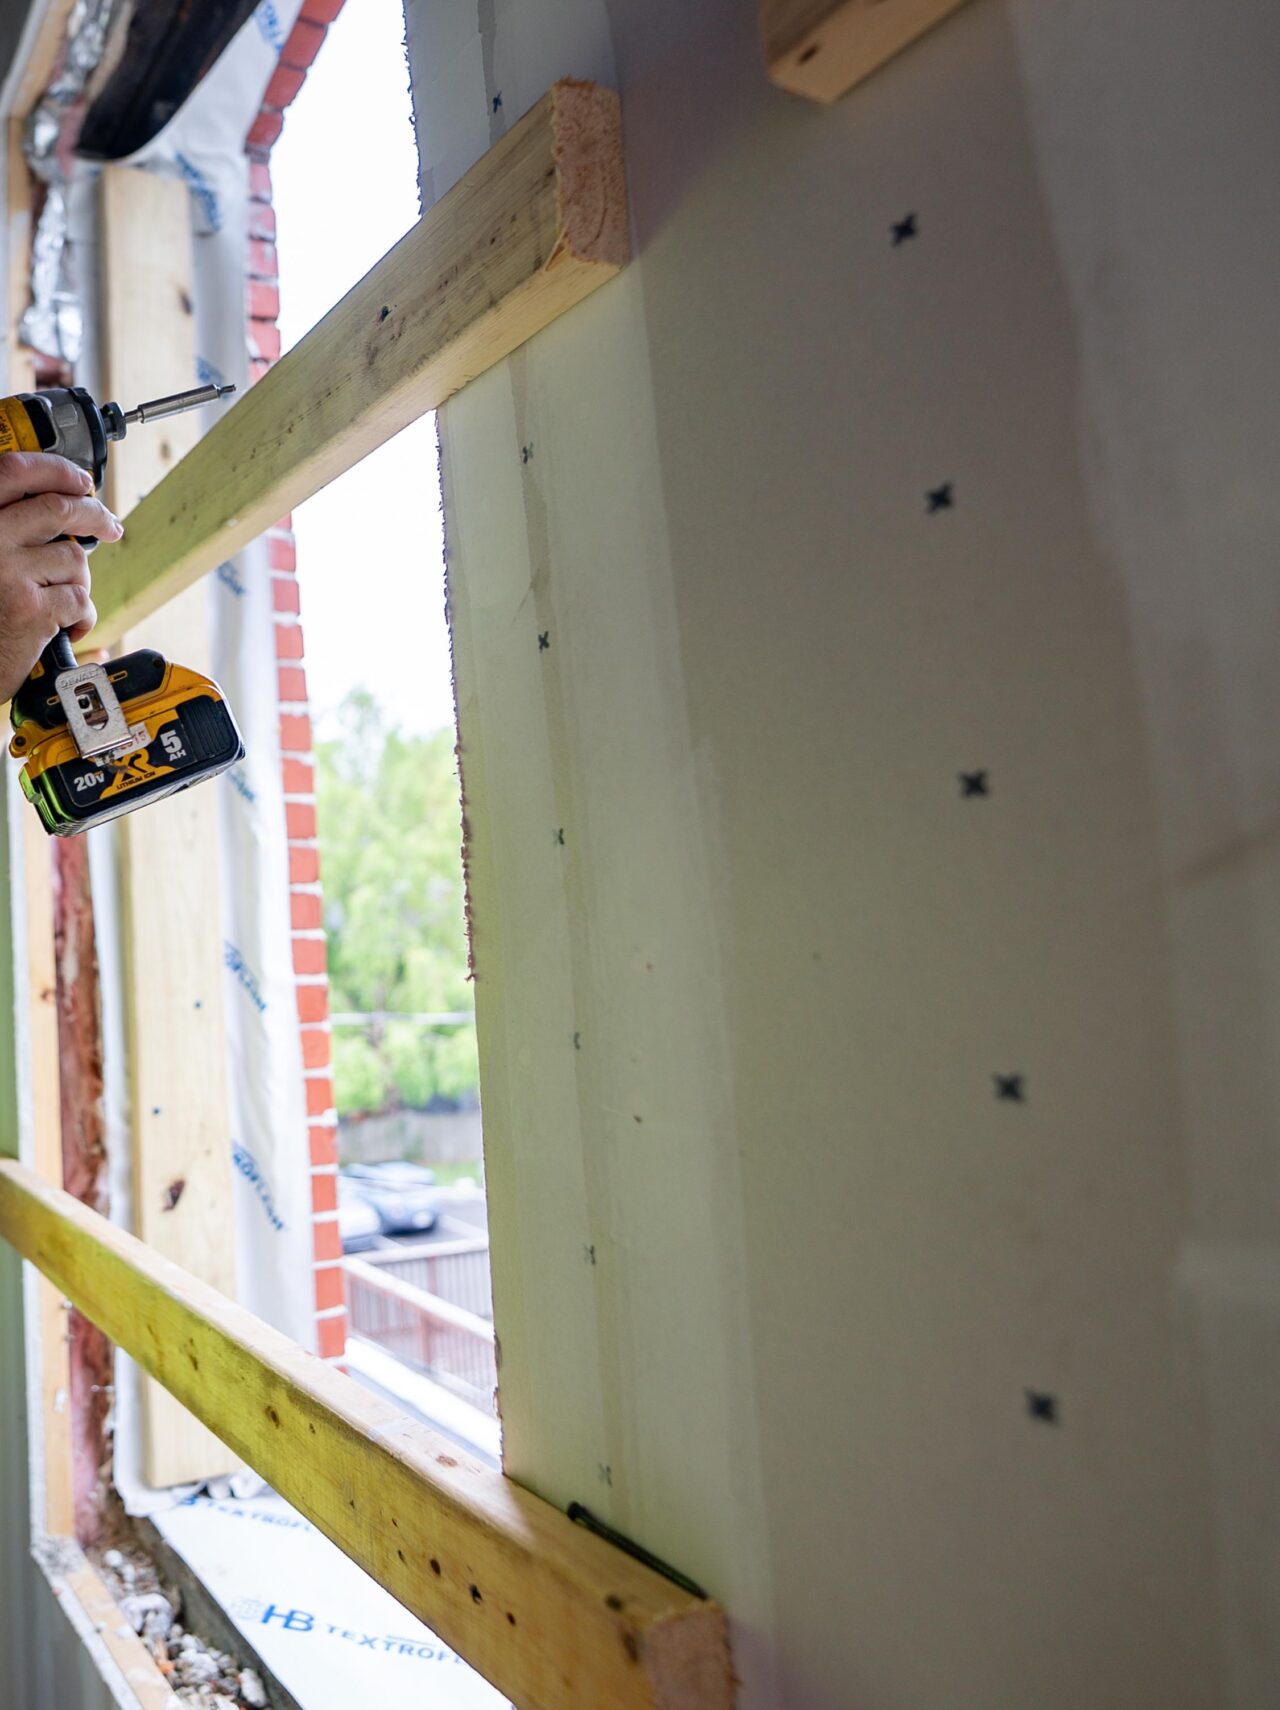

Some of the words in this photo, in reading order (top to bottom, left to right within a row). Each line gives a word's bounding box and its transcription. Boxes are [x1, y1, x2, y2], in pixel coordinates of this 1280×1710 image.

[159, 730, 183, 754] 5
[116, 775, 143, 790] LITHIUM
[143, 770, 157, 781] ION
[260, 1604, 315, 1633] HB
